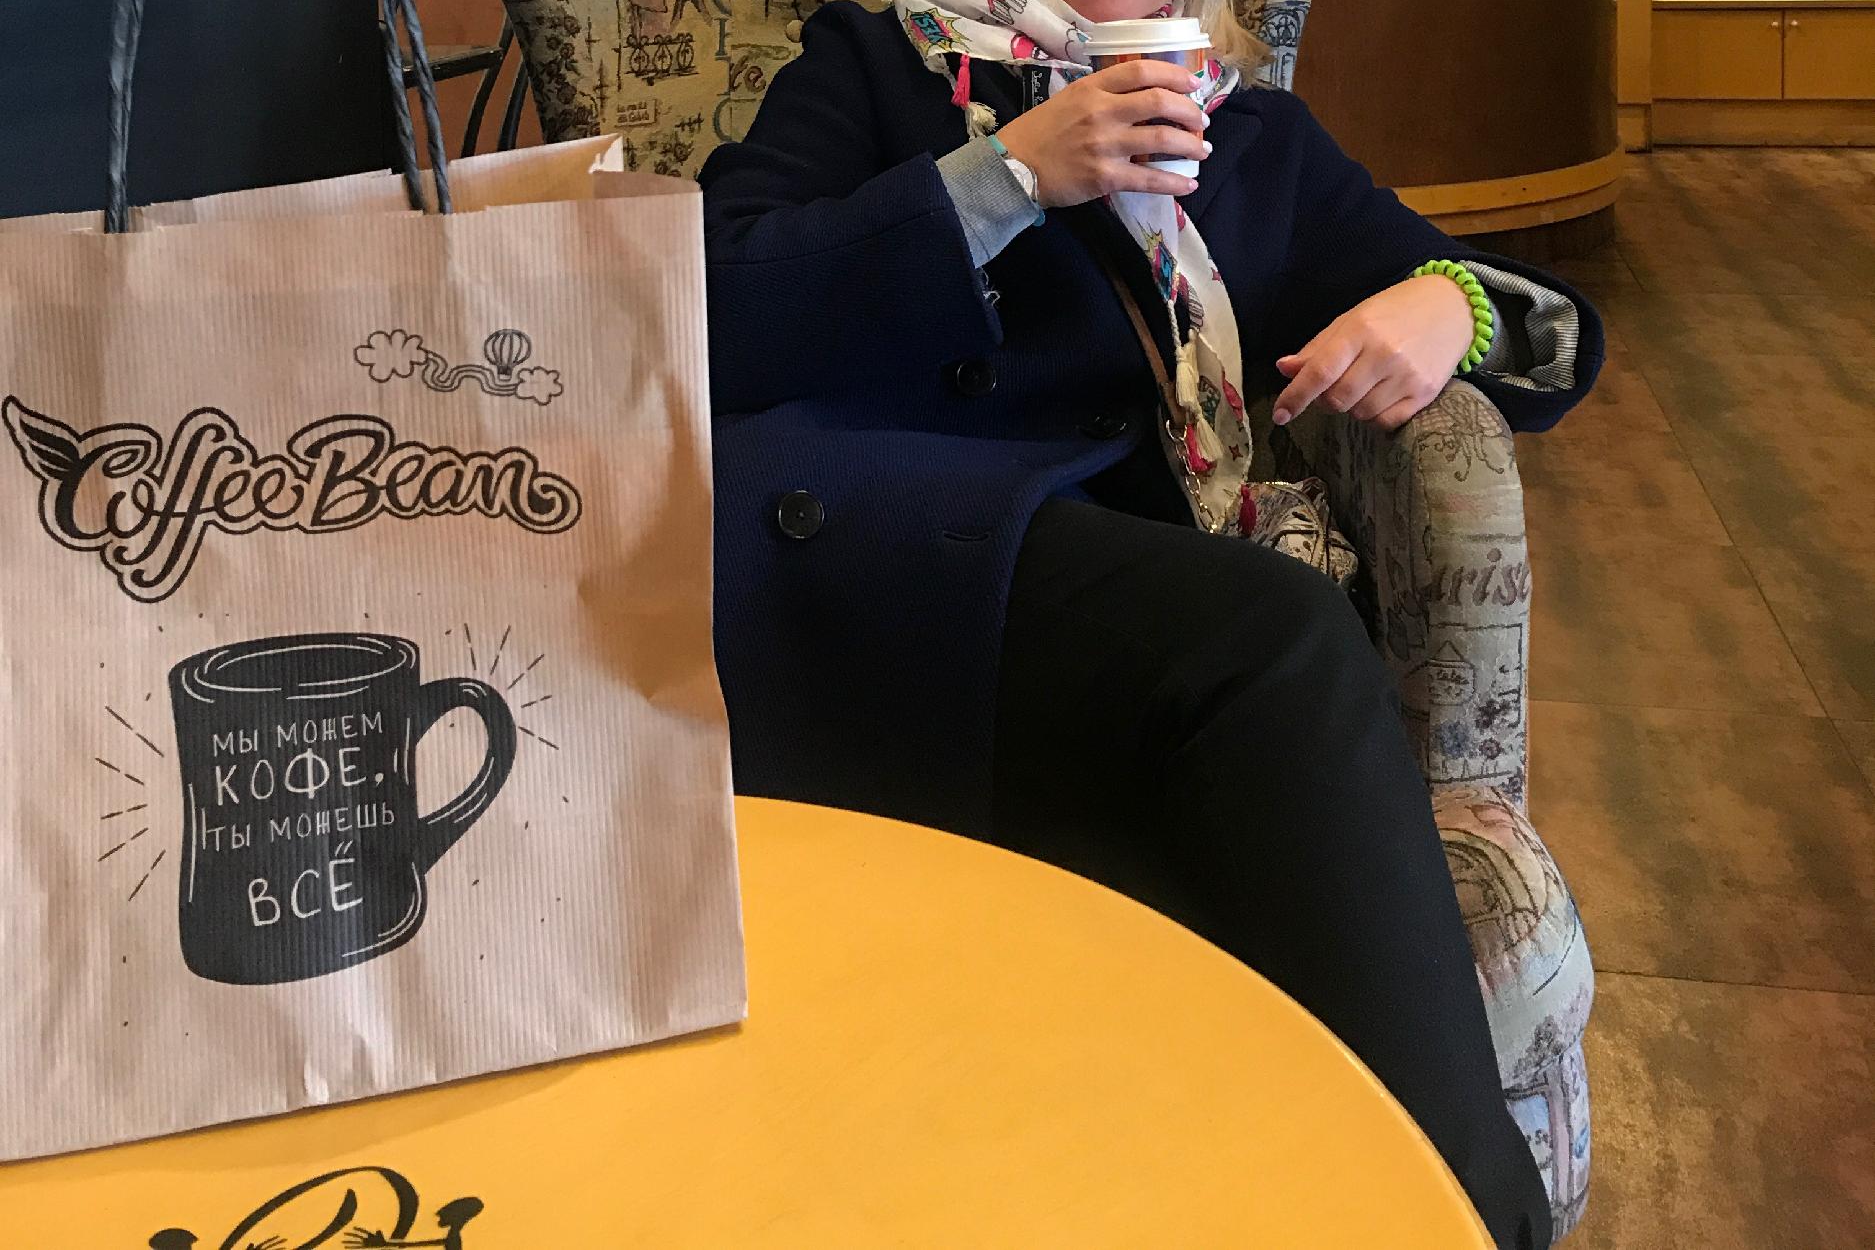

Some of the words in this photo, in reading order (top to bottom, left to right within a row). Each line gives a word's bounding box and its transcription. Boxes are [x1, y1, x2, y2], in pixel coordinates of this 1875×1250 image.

[30, 415, 305, 592] Coffee
[298, 422, 575, 530] Bean
[212, 728, 259, 758] МЫ
[277, 711, 384, 749] МОЖЕМ
[214, 747, 385, 806] КОФЕ,
[205, 822, 251, 852] ТЫ
[269, 801, 396, 844] МОЖЕШЬ
[247, 839, 364, 928] ВСЁ
